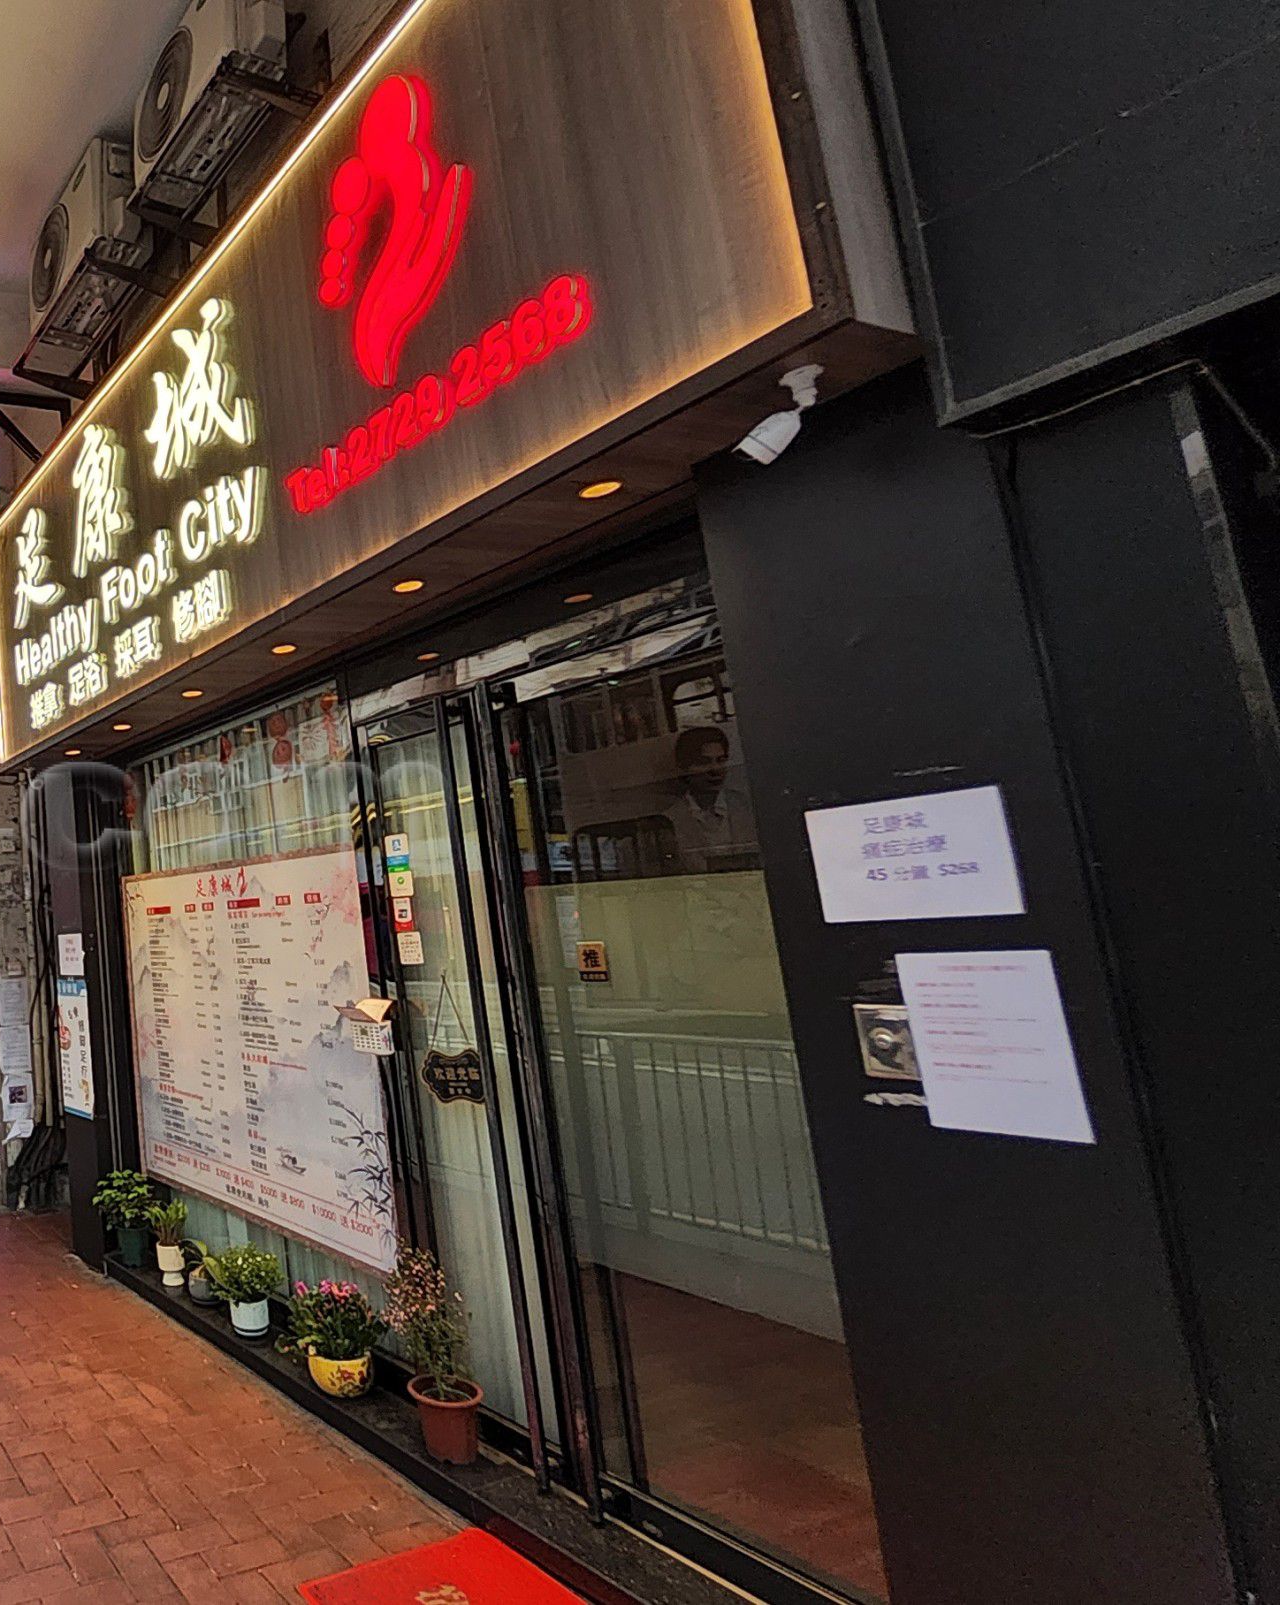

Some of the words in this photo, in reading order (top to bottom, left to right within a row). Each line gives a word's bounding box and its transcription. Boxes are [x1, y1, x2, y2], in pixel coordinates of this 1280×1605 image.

[451, 275, 592, 407] 2568
[13, 597, 99, 686] Healthy
[100, 528, 178, 625] Foot
[179, 465, 267, 563] City
[67, 651, 109, 707] 足浴
[867, 867, 889, 881] 45
[581, 949, 602, 968] 推
